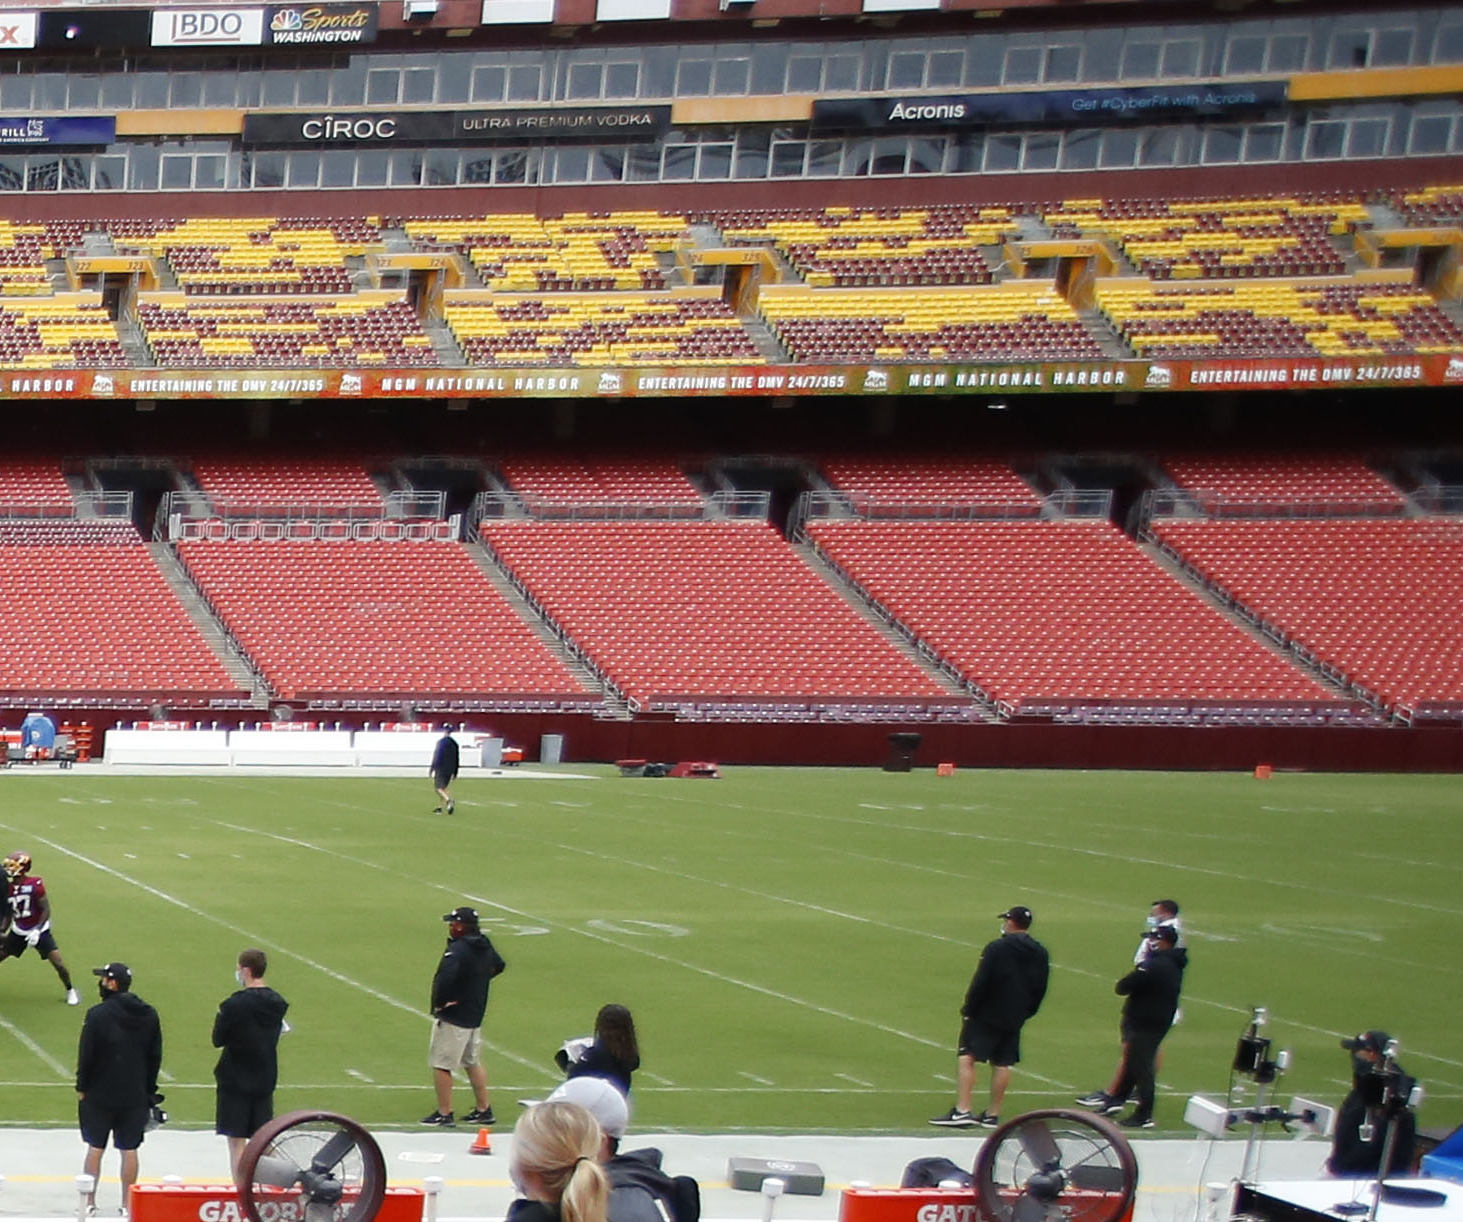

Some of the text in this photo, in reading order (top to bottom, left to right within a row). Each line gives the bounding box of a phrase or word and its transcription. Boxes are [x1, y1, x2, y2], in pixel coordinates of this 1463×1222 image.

[181, 14, 241, 36] BDO
[301, 8, 368, 30] Sports
[889, 104, 965, 120] Acronis
[302, 115, 395, 139] CÎROC
[463, 113, 652, 130] ULTRA PREMIUM VODKA
[909, 371, 1124, 386] MGM NATIONAL HARBOR
[1191, 366, 1420, 382] ENTERTAINING THE DMV 24/7/365
[12, 379, 73, 391] HARBOR
[131, 378, 323, 392] ENTERTAINING THE DMV 24/7/365
[382, 377, 578, 390] MGM NATIONAL HARBOR
[639, 376, 845, 389] ENTERTAINING THE DMV 24/7/365
